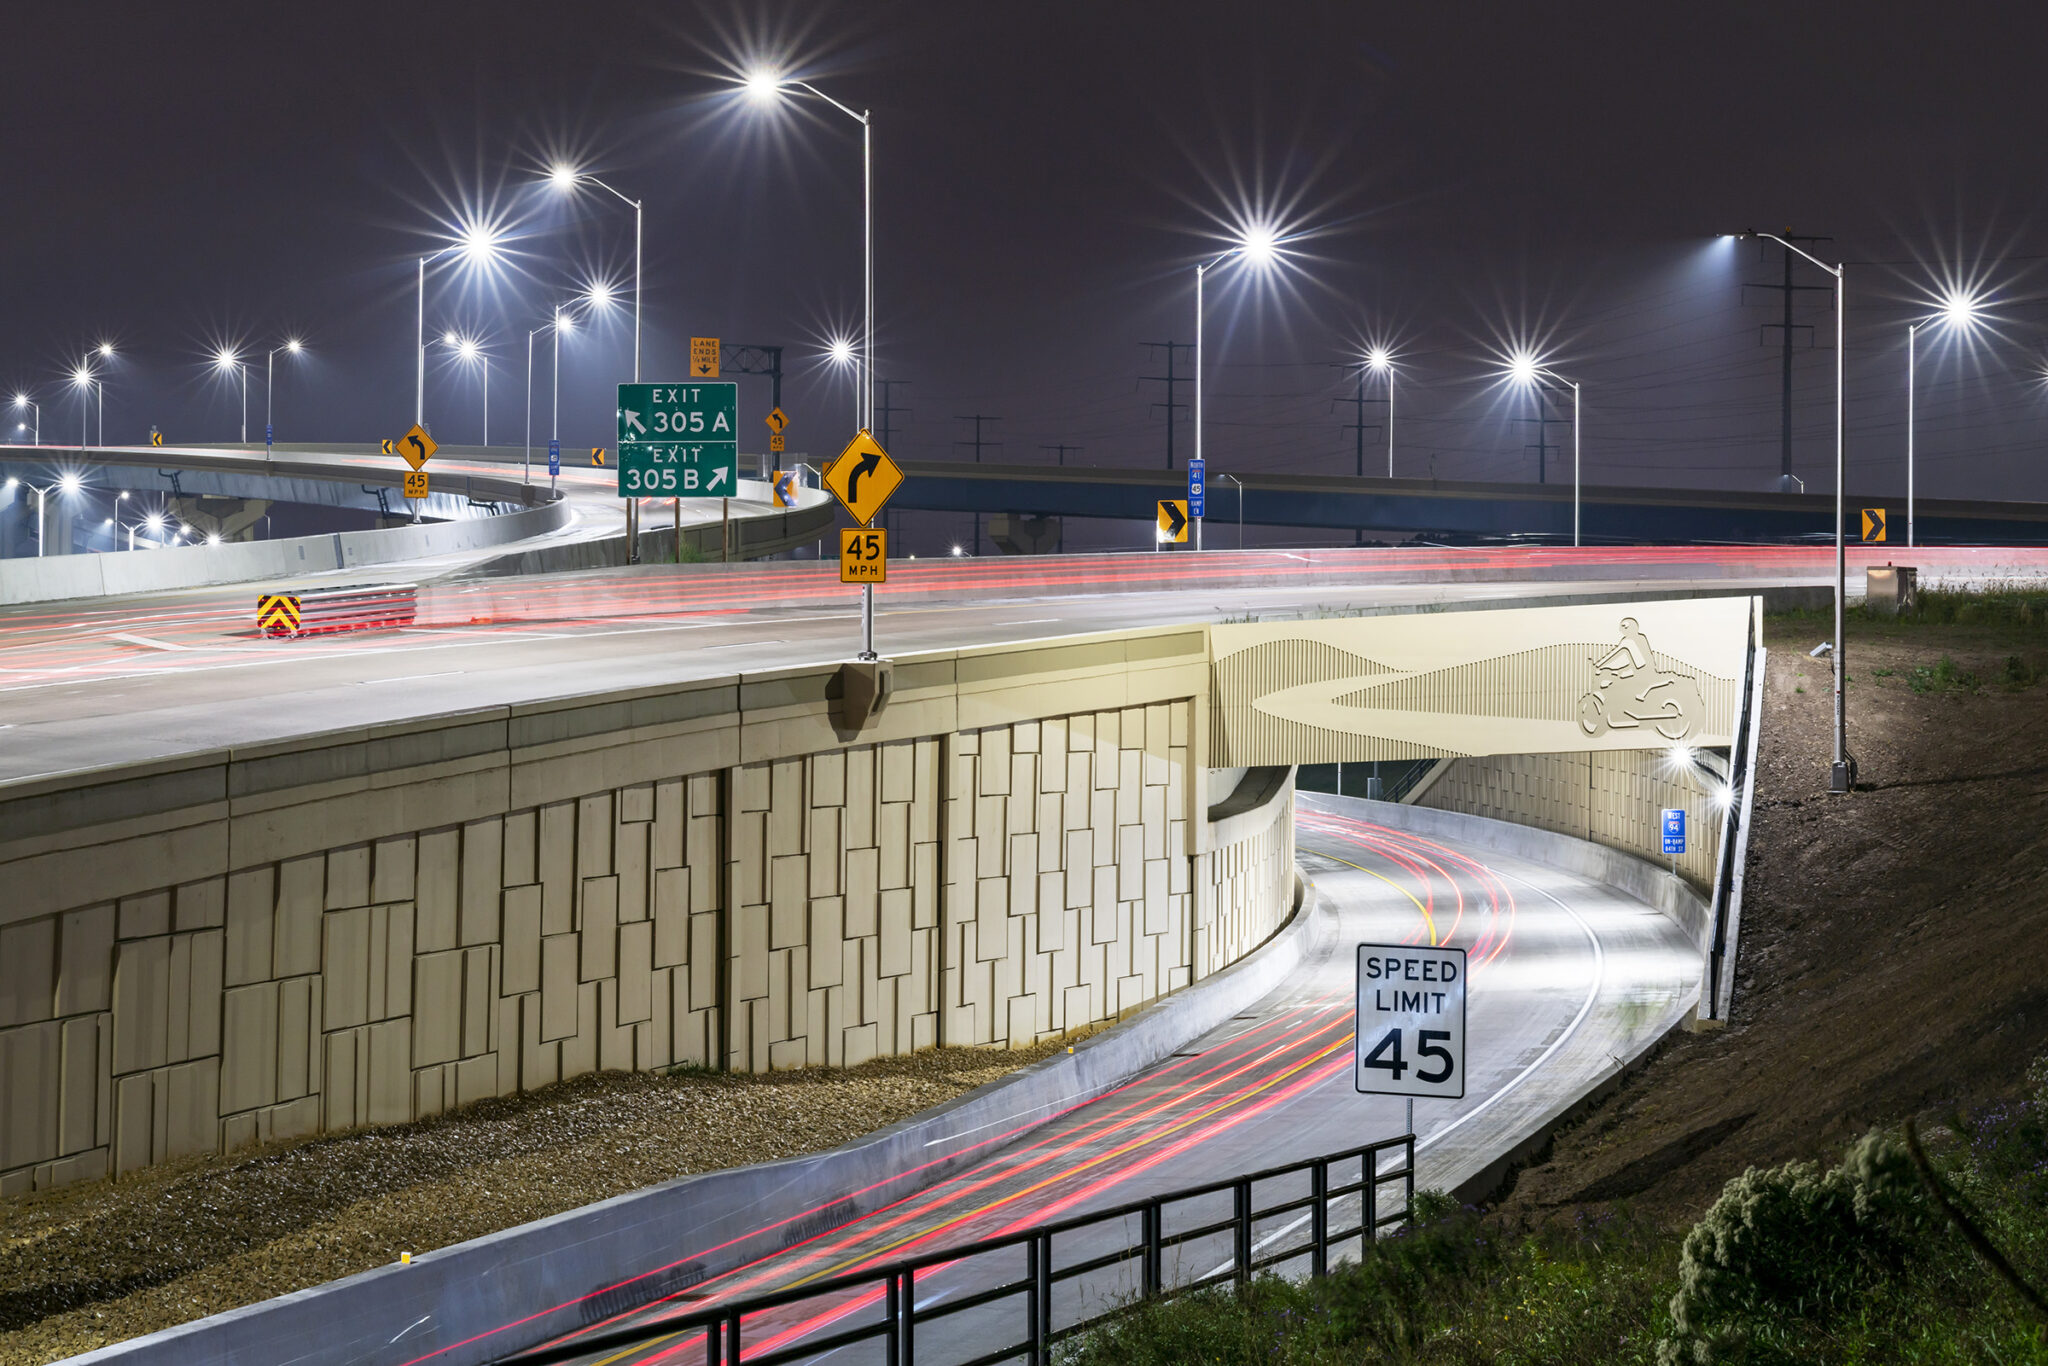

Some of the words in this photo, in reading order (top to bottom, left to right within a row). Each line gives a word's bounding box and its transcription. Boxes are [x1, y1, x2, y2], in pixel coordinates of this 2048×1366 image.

[652, 389, 701, 403] EXIT
[654, 411, 704, 433] 305
[712, 411, 730, 432] A
[772, 437, 783, 445] 45
[653, 448, 701, 463] EXIT
[407, 474, 425, 487] 45
[626, 468, 677, 490] 305
[1192, 485, 1201, 493] 45
[846, 535, 880, 560] 45
[849, 565, 878, 575] MPH
[1669, 823, 1679, 831] 94
[1366, 957, 1457, 982] SPEED
[1376, 989, 1446, 1014] LIMIT
[1364, 1028, 1454, 1083] 45
